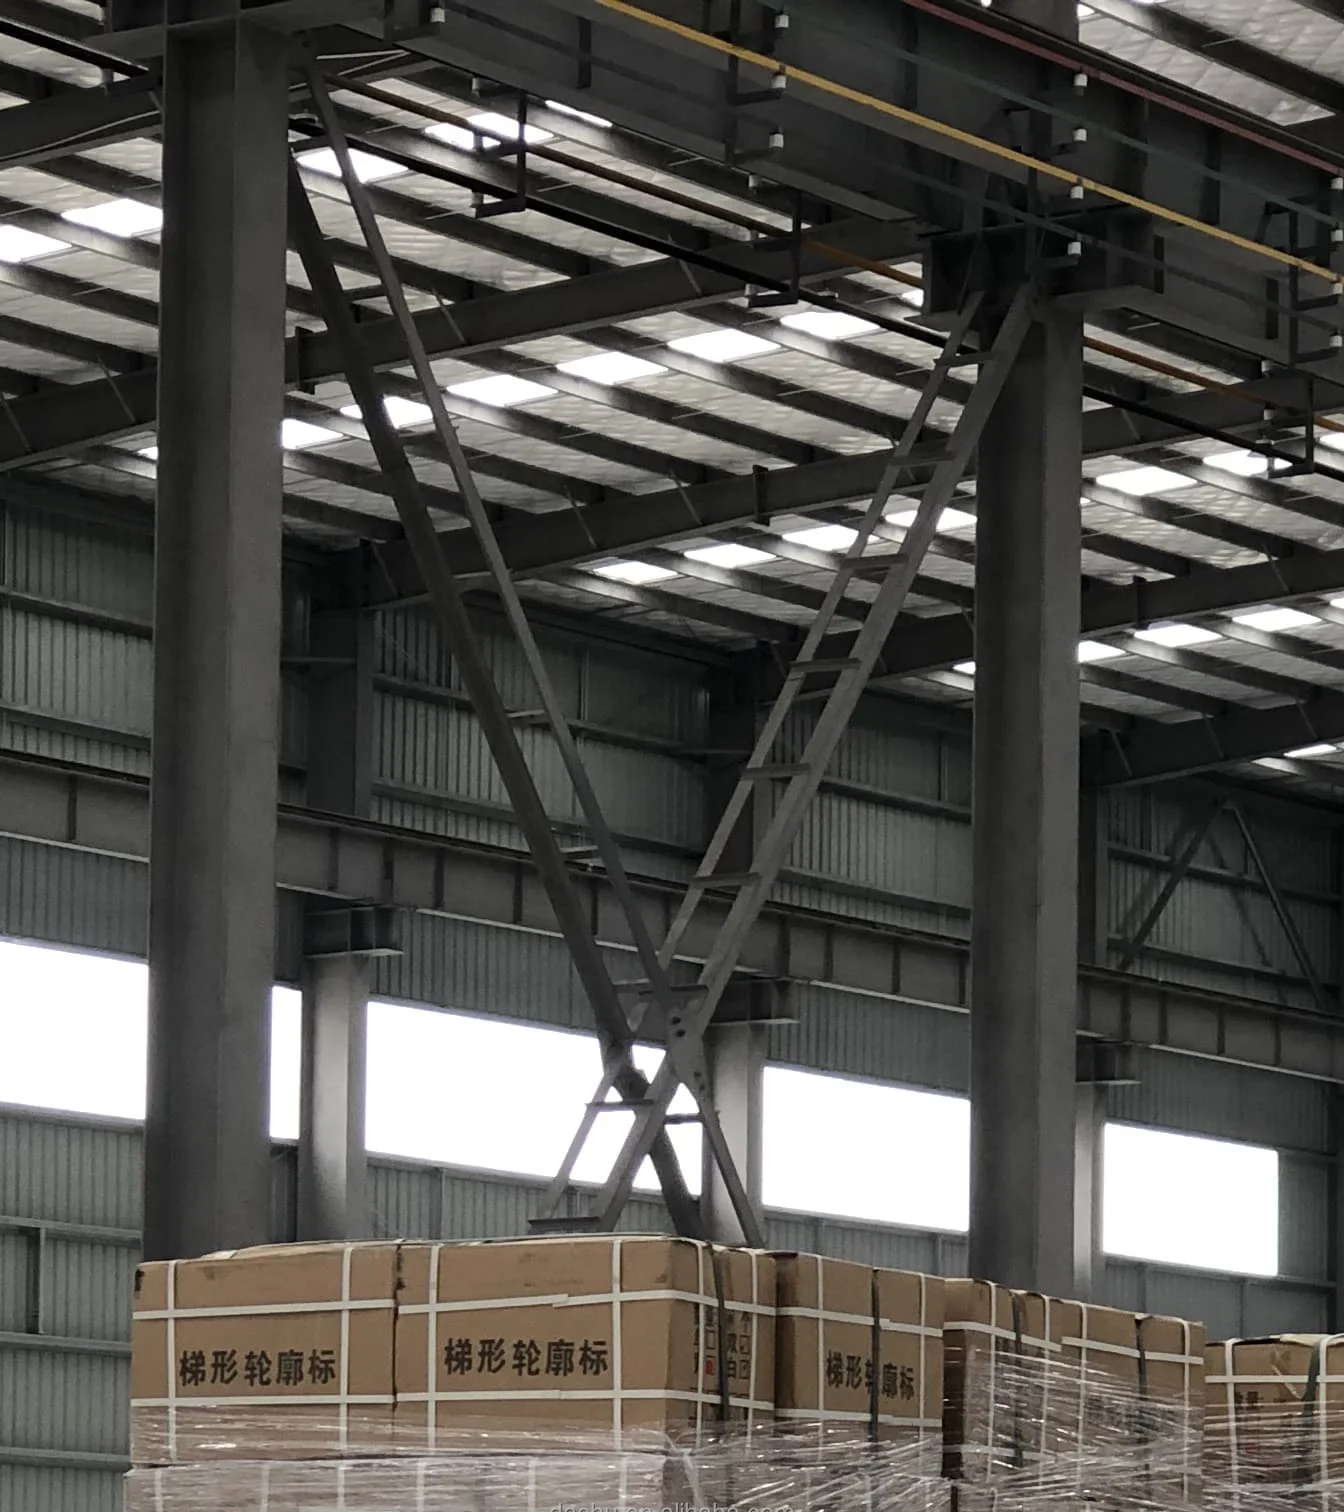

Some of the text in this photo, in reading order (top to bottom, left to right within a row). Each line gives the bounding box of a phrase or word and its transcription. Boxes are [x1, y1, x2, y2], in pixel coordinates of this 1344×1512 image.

[179, 1347, 337, 1388] 梯形轮廓标
[443, 1337, 609, 1378] 梯形轮廓标
